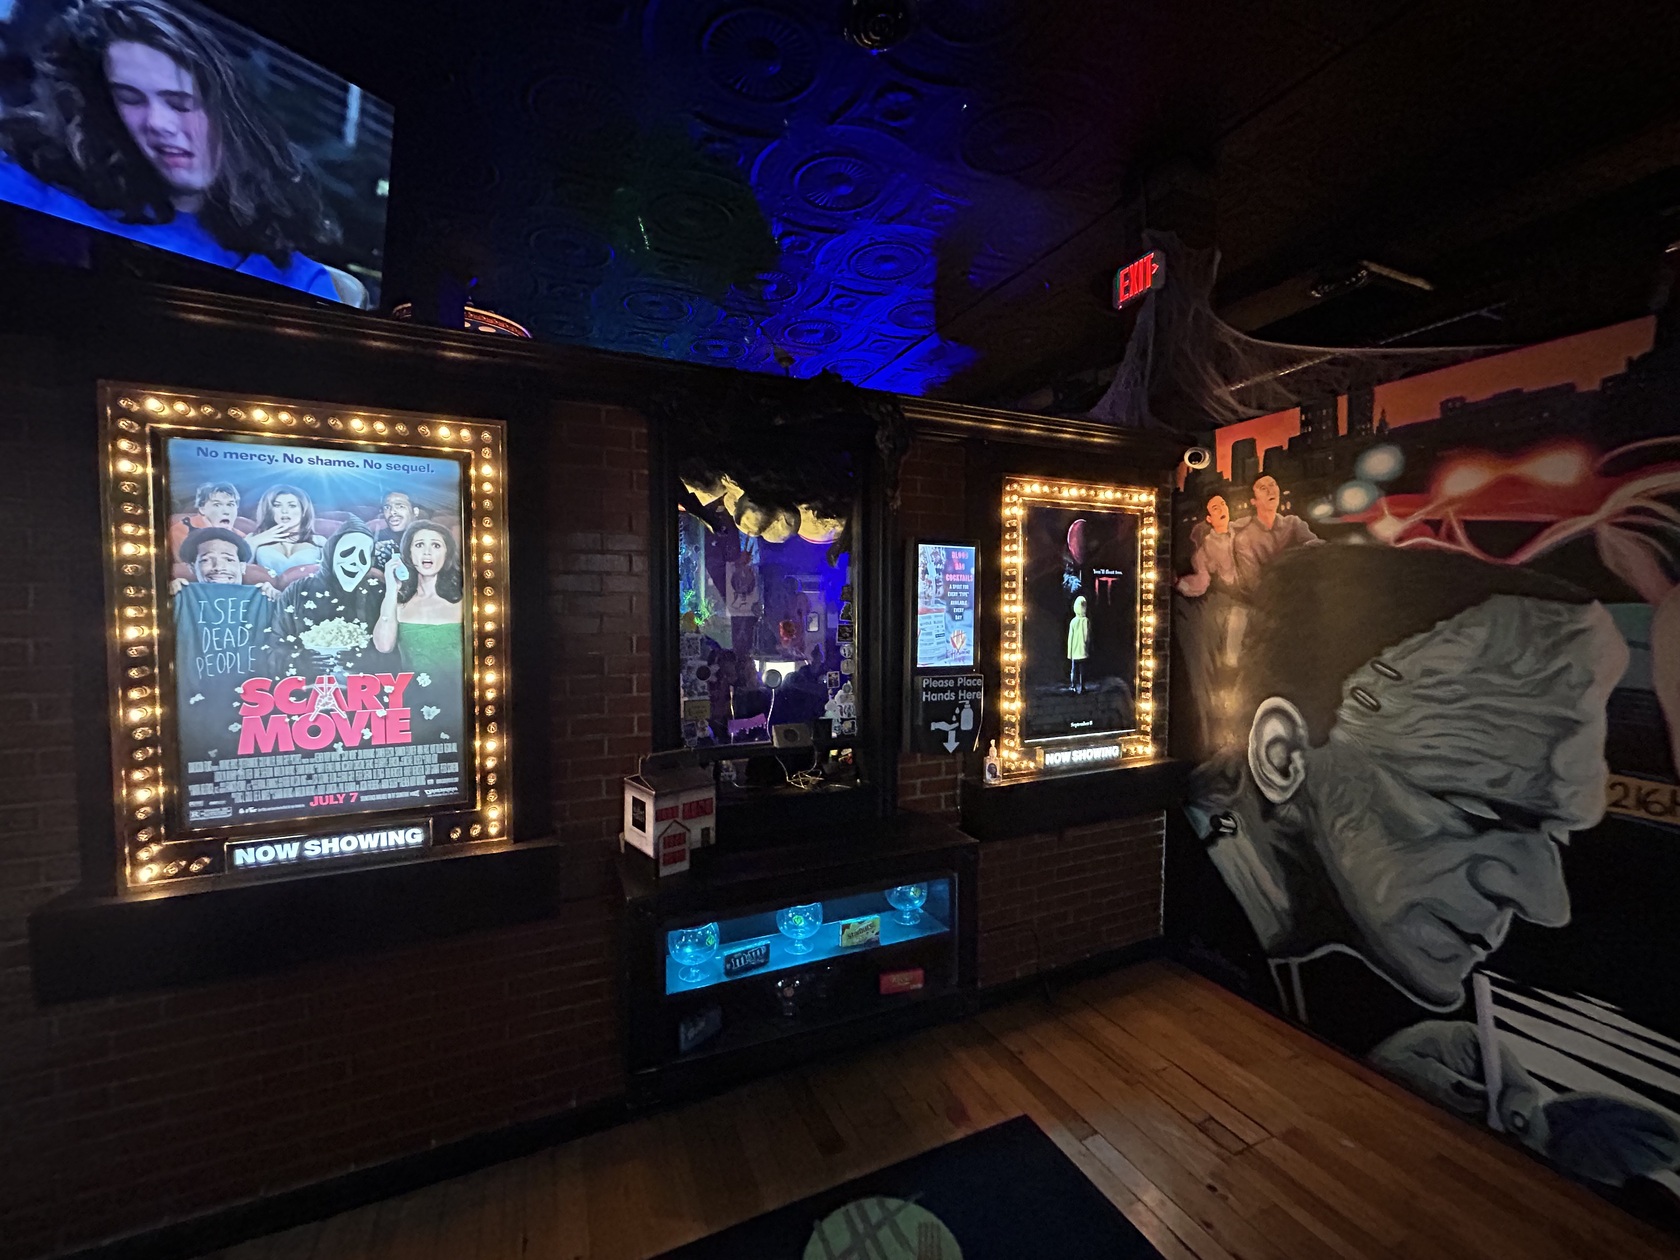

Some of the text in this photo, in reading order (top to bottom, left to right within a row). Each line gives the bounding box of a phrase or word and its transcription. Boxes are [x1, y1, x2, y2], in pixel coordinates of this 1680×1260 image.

[1119, 252, 1154, 302] EXIT
[197, 446, 435, 474] No mercy. No shame. No sequel.
[945, 574, 974, 582] COCKTAILS
[1094, 576, 1119, 604] IT
[197, 597, 251, 625] I SEE
[202, 626, 250, 654] DEAD
[195, 645, 257, 680] PEOPLE
[239, 672, 415, 718] SCARY
[922, 676, 982, 688] Please Place
[922, 689, 982, 702] Hands Here
[237, 708, 412, 755] MOVIE
[1045, 745, 1120, 766] NOW SHOWING
[309, 793, 350, 807] JULY
[350, 792, 359, 803] 7
[233, 827, 425, 866] NOW SHOWING
